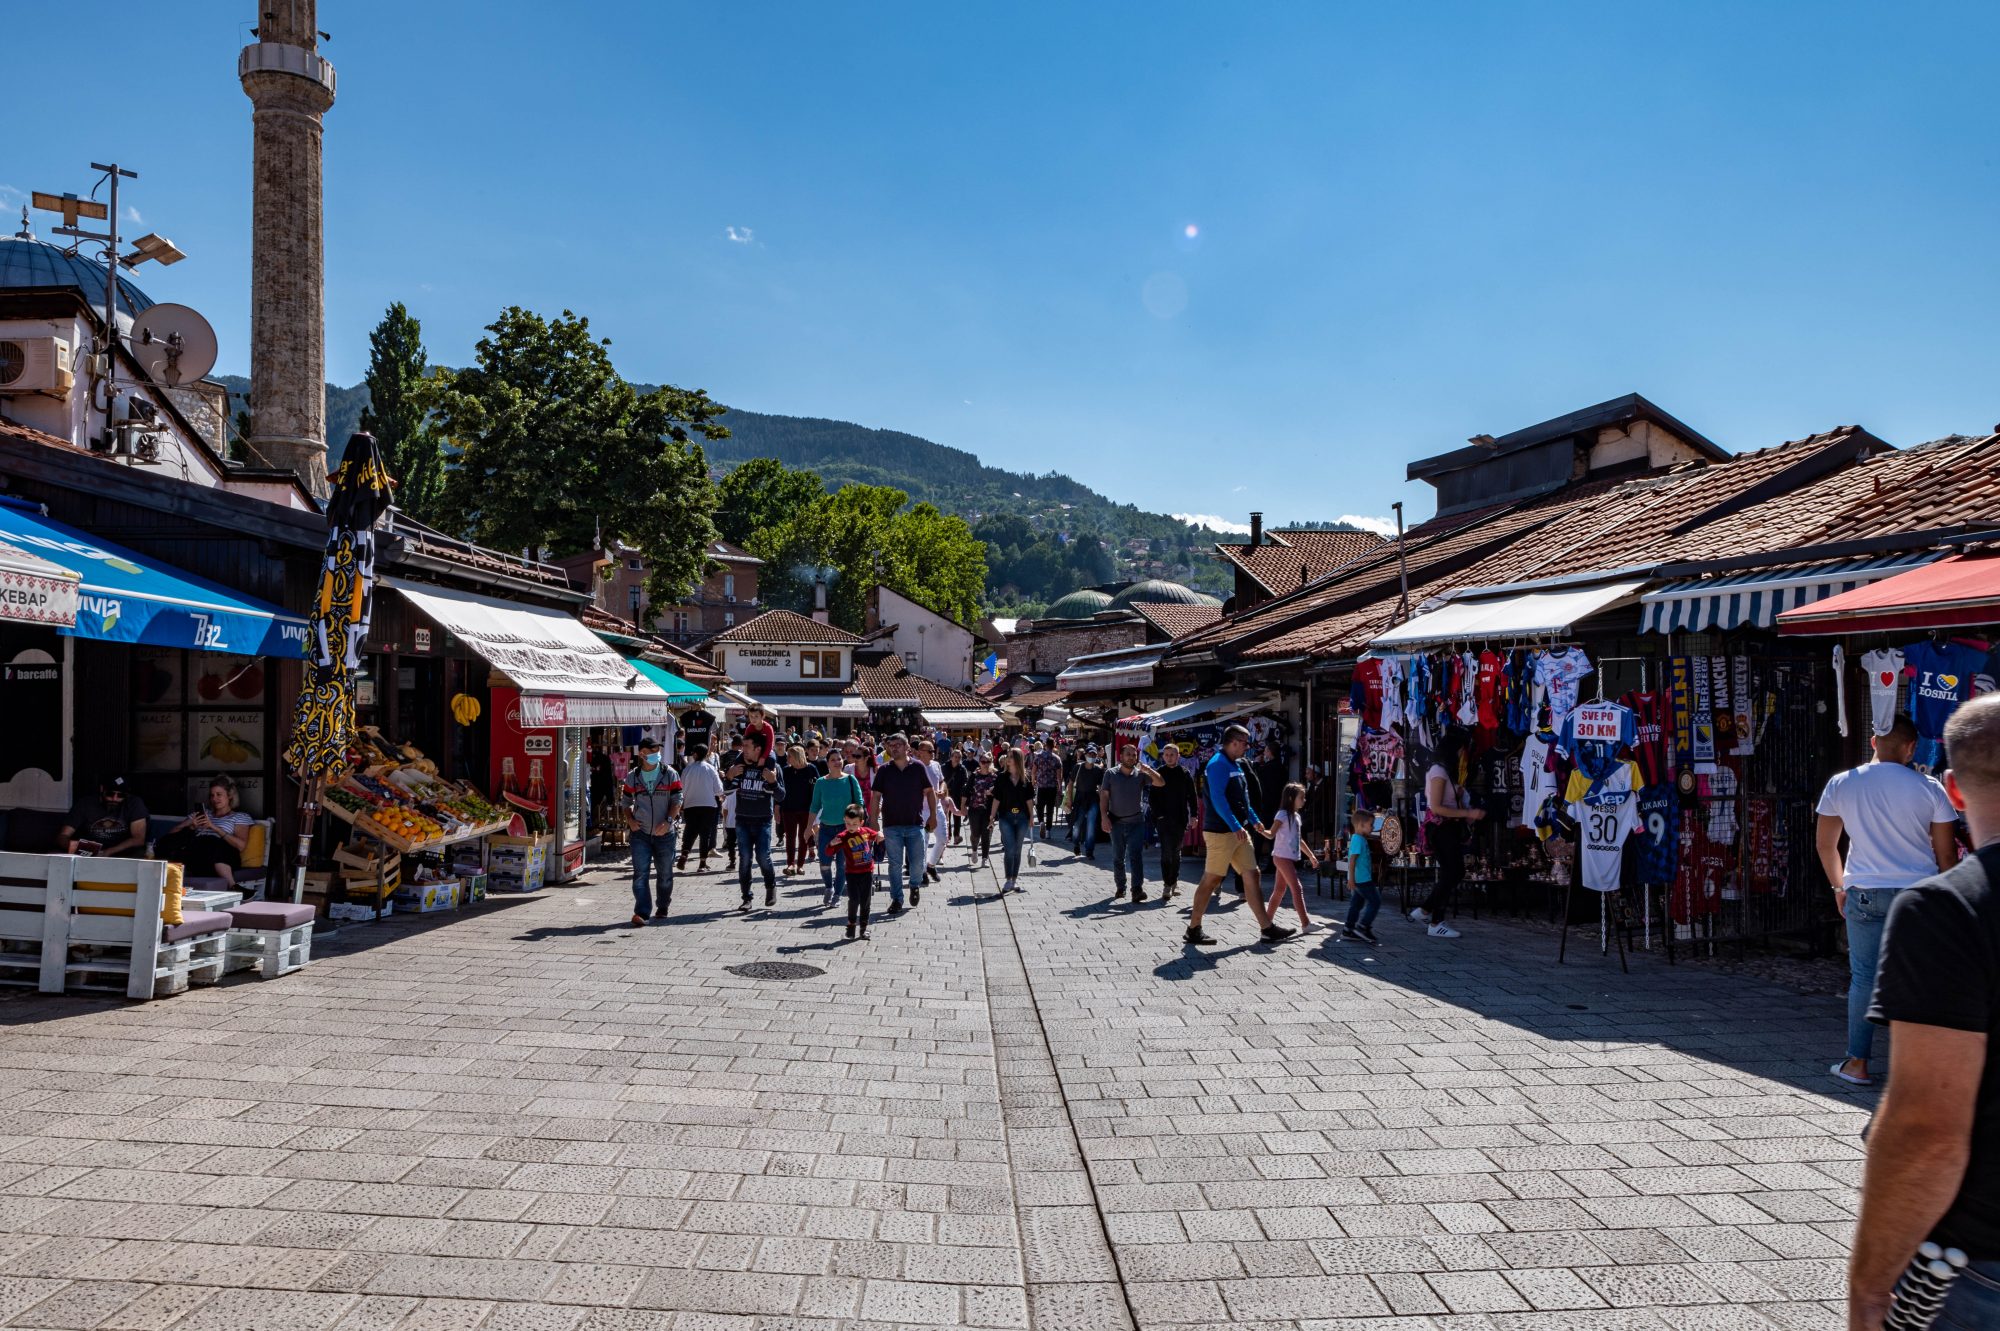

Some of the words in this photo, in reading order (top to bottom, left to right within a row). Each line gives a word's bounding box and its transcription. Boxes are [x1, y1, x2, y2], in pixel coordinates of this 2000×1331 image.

[0, 588, 47, 607] KEBAP
[785, 659, 791, 667] 2
[1921, 672, 1933, 687] I
[1673, 657, 1689, 752] INTER
[1581, 710, 1599, 721] SVE
[1600, 711, 1614, 722] PO
[1577, 723, 1595, 736] 30
[1597, 724, 1617, 737] KM
[1369, 751, 1388, 774] 30
[1592, 804, 1617, 814] MESSI
[1641, 799, 1668, 811] UKAKU
[1589, 813, 1618, 844] 30
[1648, 811, 1665, 846] 9
